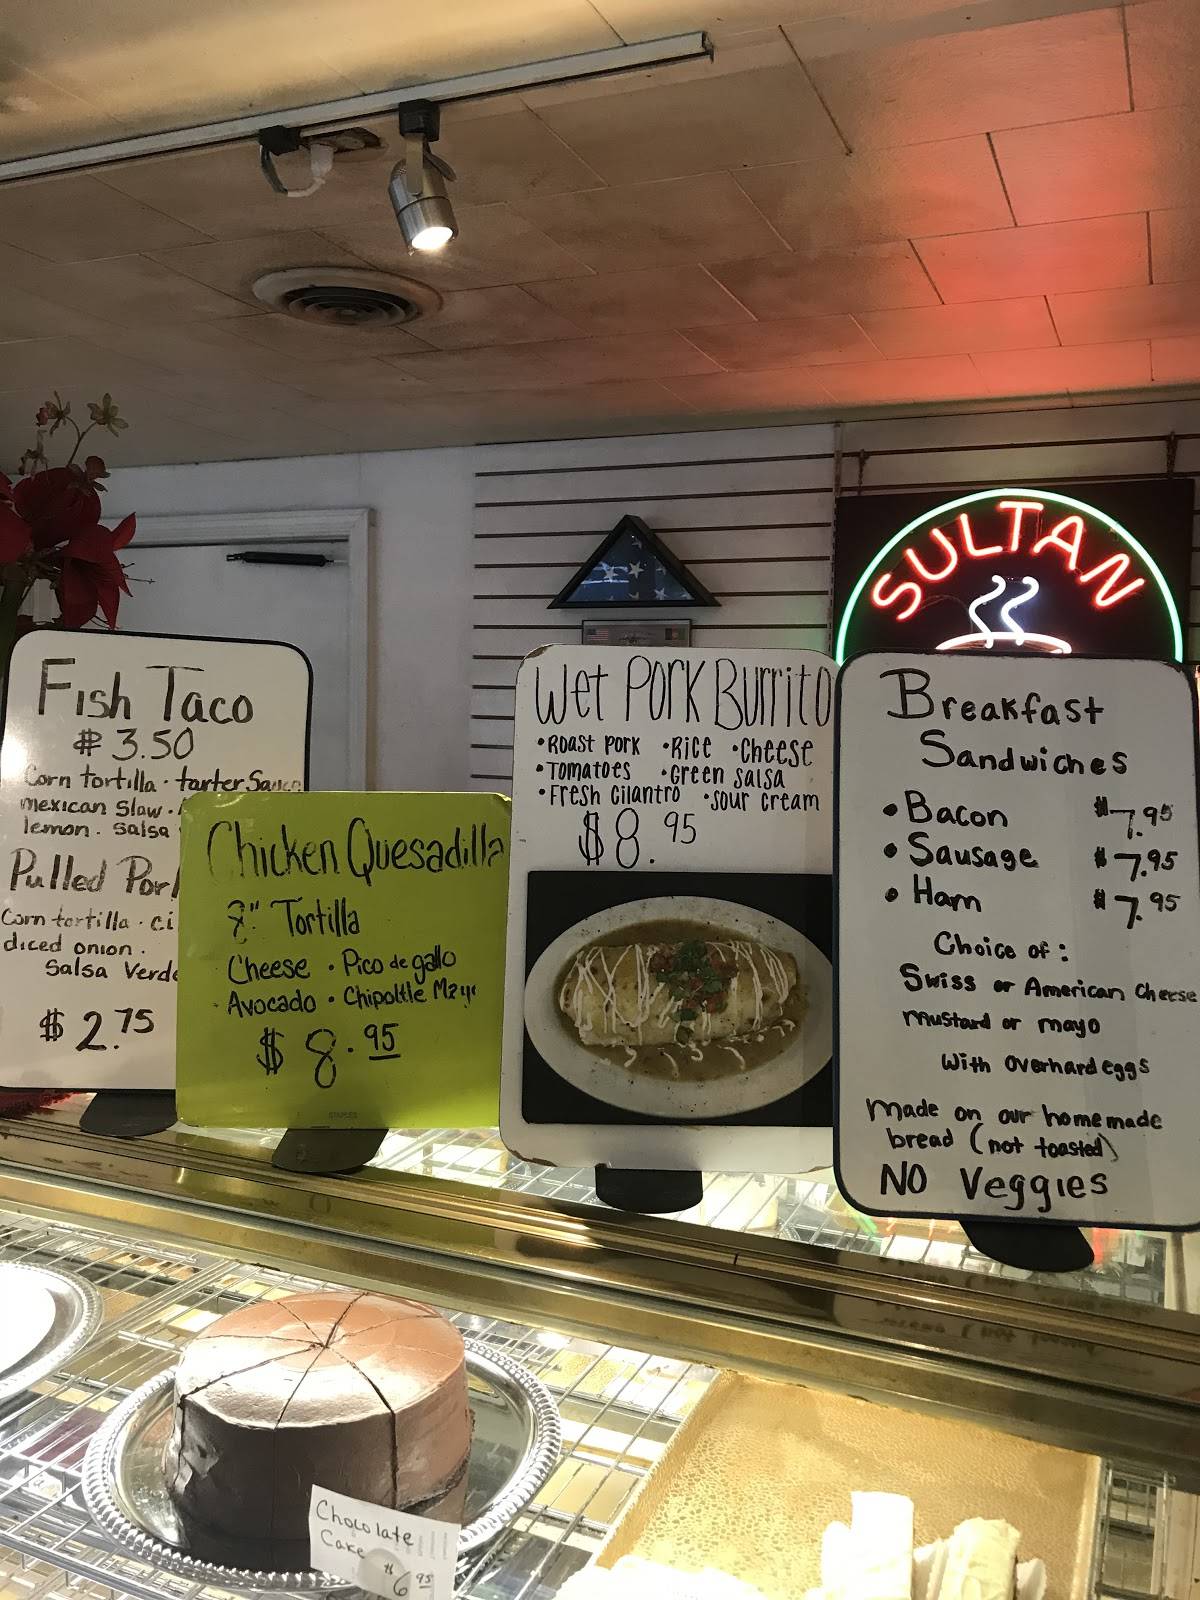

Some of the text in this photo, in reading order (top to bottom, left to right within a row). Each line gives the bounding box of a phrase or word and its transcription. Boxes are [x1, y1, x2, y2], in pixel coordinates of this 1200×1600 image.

[871, 499, 1147, 621] SULTAN
[38, 658, 254, 724] Fish Taco
[535, 663, 609, 725] Wet
[714, 658, 832, 730] Burrito
[880, 667, 1105, 725] Breakfast
[671, 736, 712, 760] Rice
[740, 738, 814, 768] Cheese
[920, 728, 1128, 775] Sandwiches
[24, 764, 71, 789] Corn
[80, 764, 157, 793] tortilla
[548, 761, 632, 781] Tomatoes
[670, 763, 724, 785] Green
[550, 784, 601, 806] Fresh
[905, 790, 1008, 827] Bacon
[24, 818, 170, 838] lemon salsa
[207, 817, 505, 886] Chicken Quesadilla
[908, 831, 1039, 871] Sausage
[10, 848, 108, 892] Pulled
[913, 874, 982, 912] Ham
[1, 908, 46, 926] Corn
[52, 905, 129, 931] tortilla
[270, 897, 360, 937] Tortilla
[4, 932, 132, 956] diced onion
[933, 930, 1017, 960] Choice
[227, 944, 456, 985] Cheese Pico de gallo
[900, 963, 976, 992] Swiss
[993, 979, 1016, 993] or
[1024, 977, 1125, 1000] American
[227, 990, 317, 1018] Avocado
[1002, 1016, 1022, 1030] or
[1038, 1017, 1100, 1038] mayo
[954, 1104, 982, 1121] on
[998, 1107, 1032, 1125] our
[886, 1127, 954, 1149] bread
[880, 1160, 1109, 1212] NO Veggies
[316, 1499, 414, 1546] Chocolate
[321, 1529, 365, 1559] Cake
